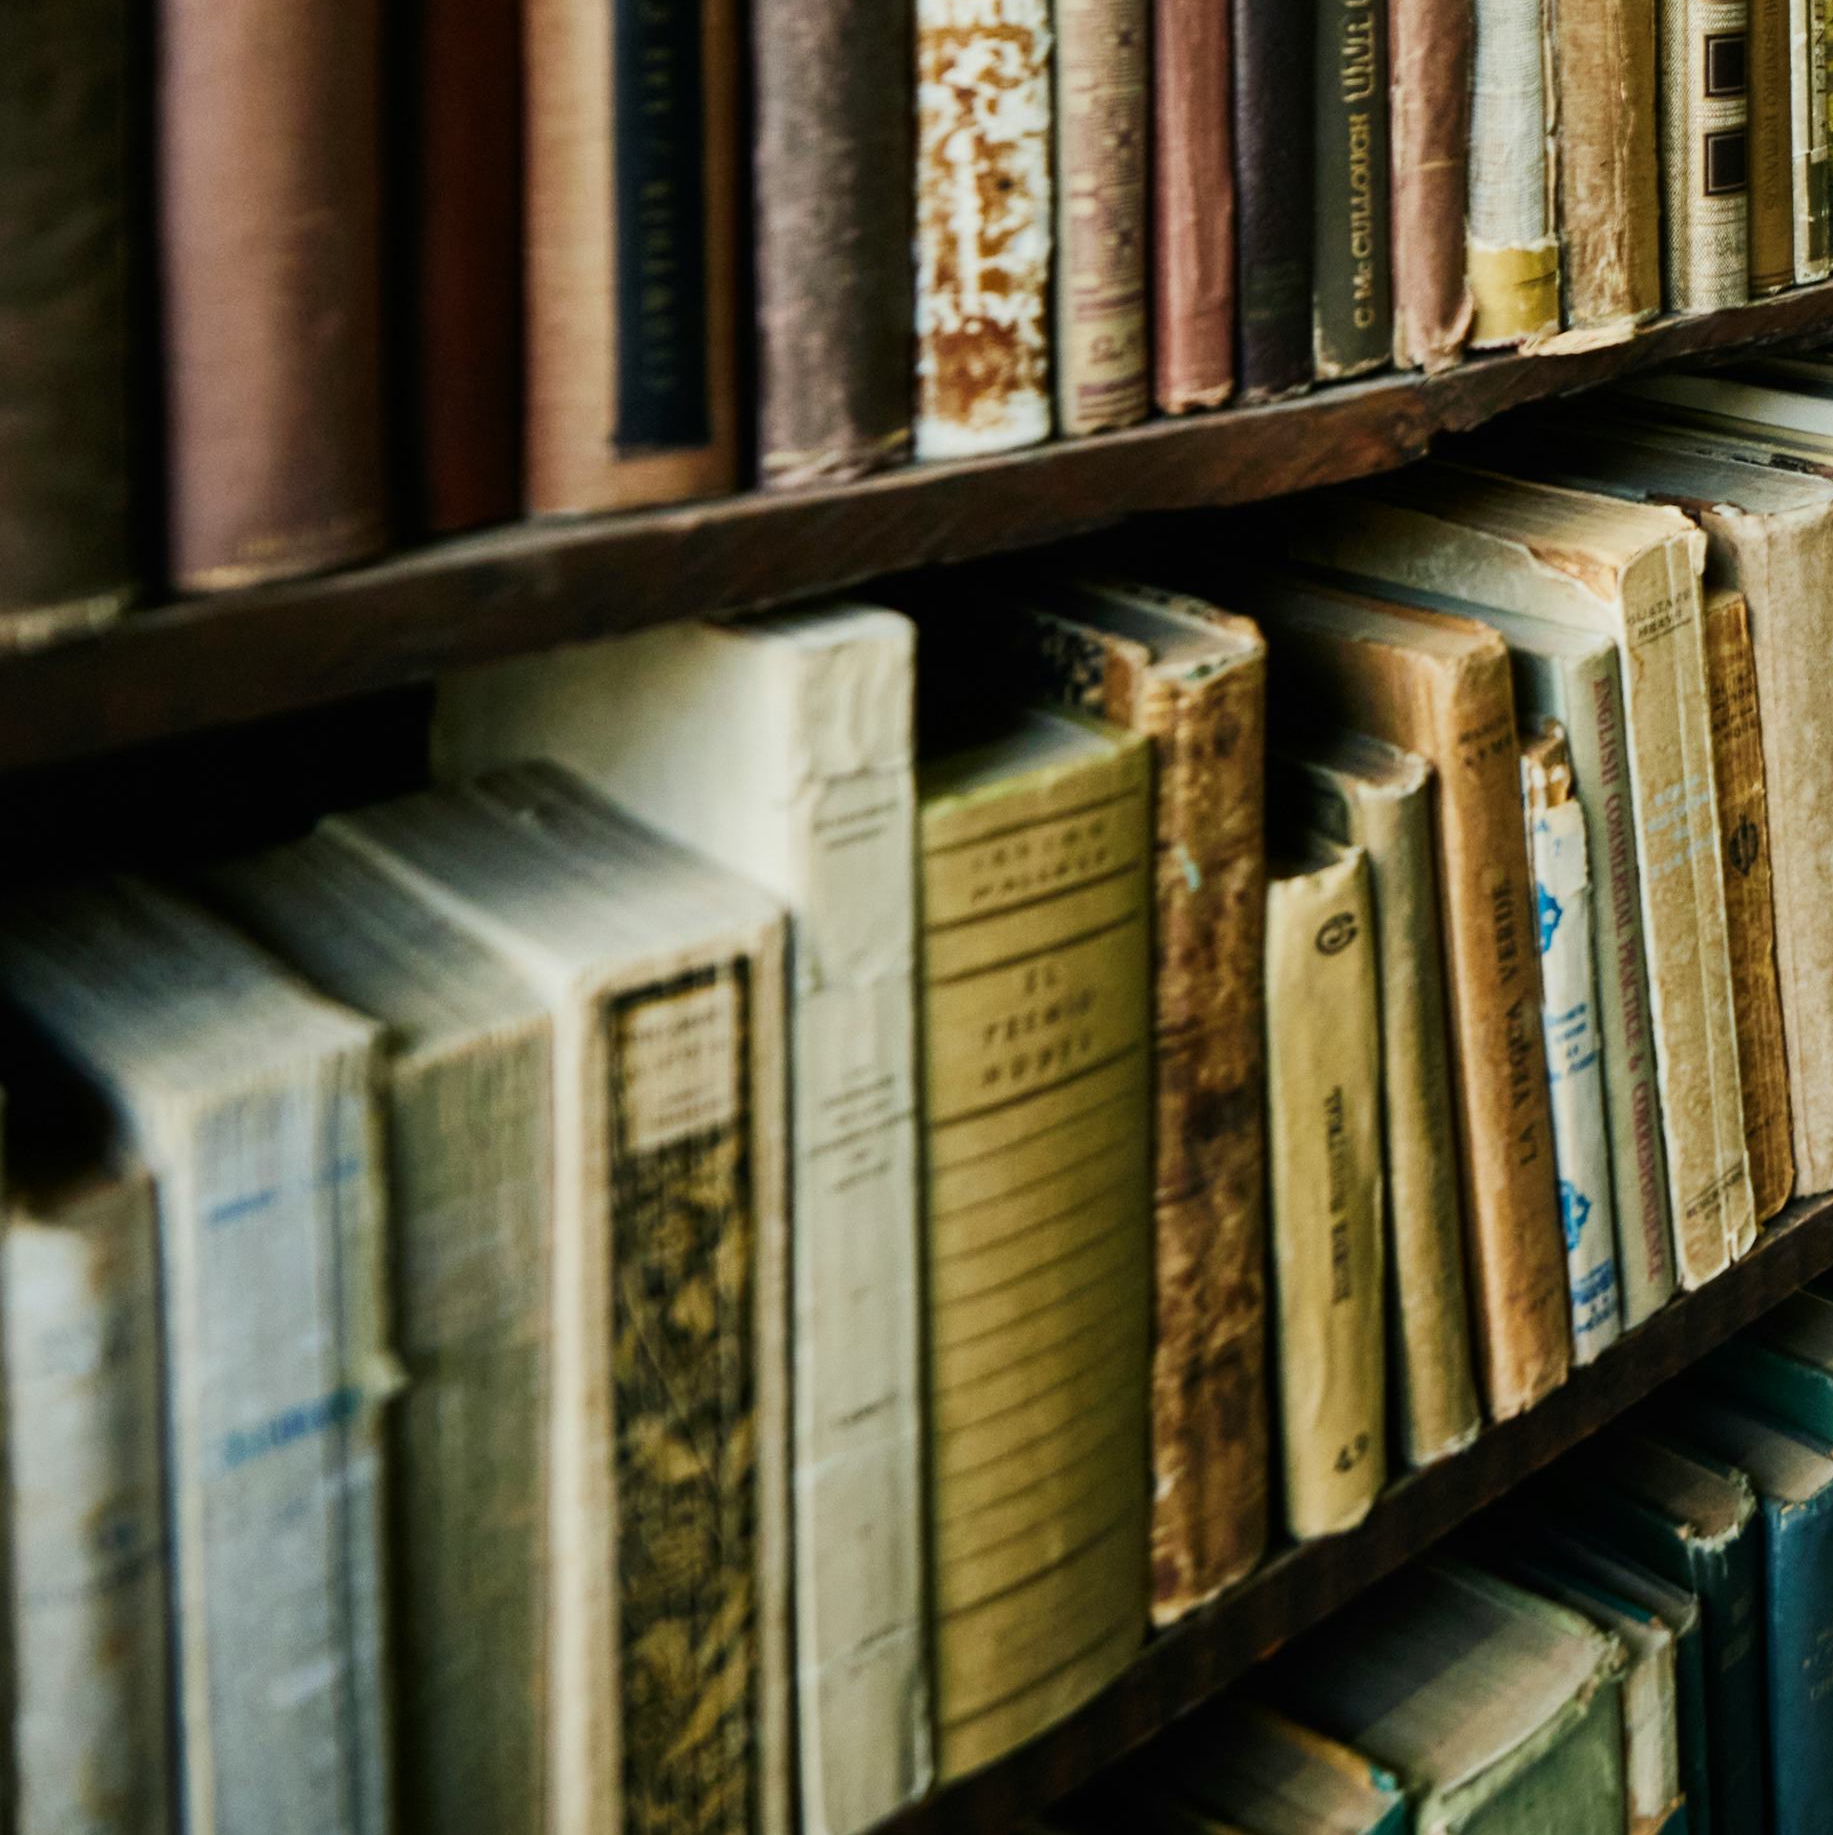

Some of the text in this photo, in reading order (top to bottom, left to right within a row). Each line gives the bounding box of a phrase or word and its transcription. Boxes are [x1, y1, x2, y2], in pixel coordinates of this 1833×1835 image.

[1339, 16, 1374, 104] UNA
[1591, 677, 1620, 786] ENGLISH
[1601, 794, 1635, 938] COMMERCIAL
[1618, 943, 1645, 1046] PRACTICE
[1628, 1083, 1664, 1280] CORRESPONDENCE
